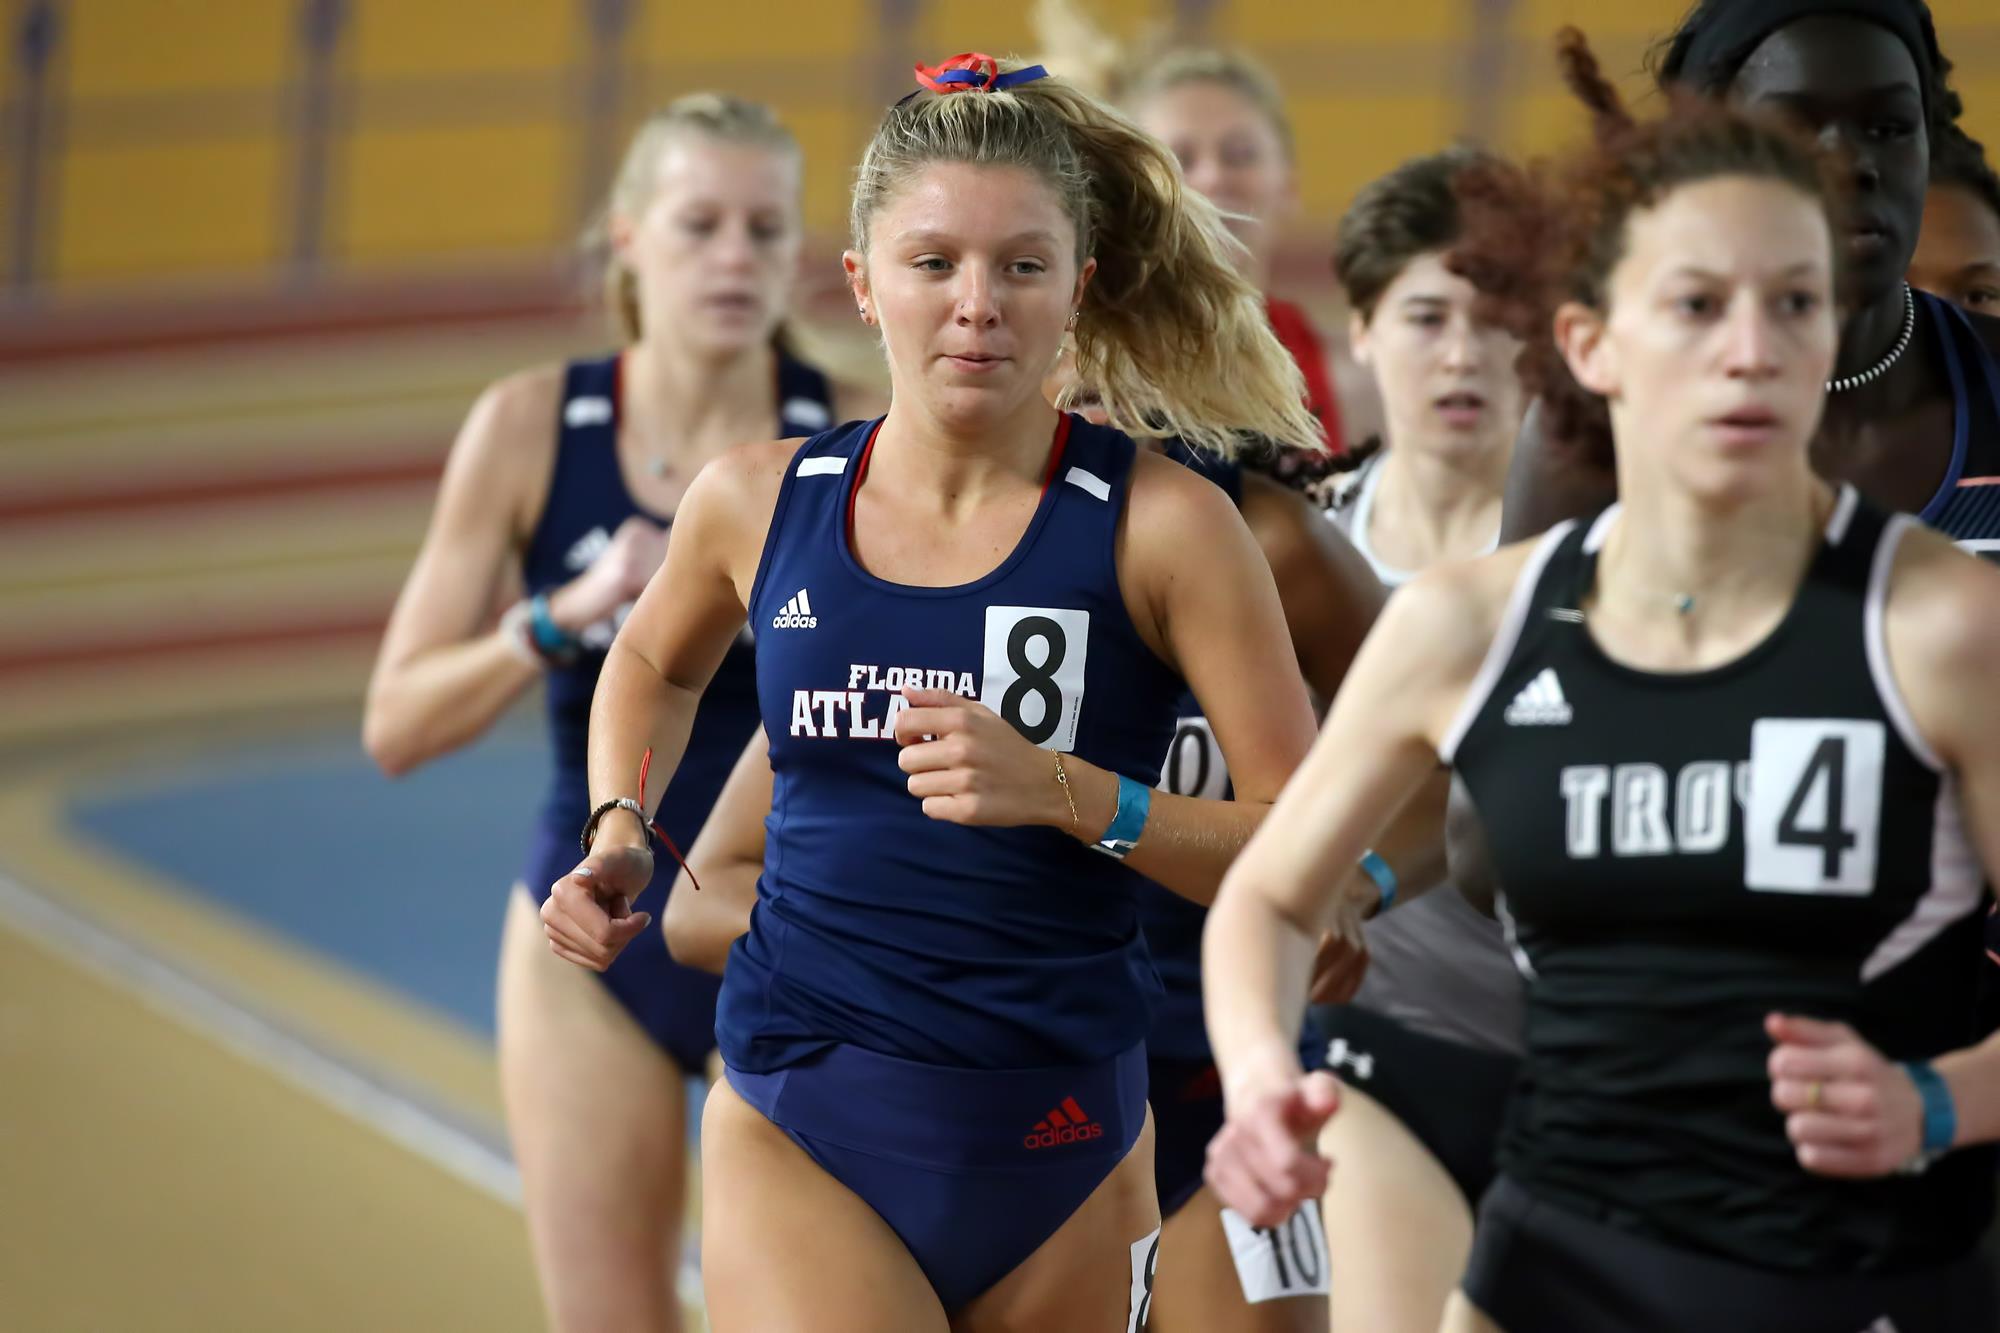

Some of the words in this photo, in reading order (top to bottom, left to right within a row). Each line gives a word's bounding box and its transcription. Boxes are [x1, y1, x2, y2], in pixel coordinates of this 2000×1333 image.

[773, 613, 817, 628] adidas
[848, 664, 976, 697] FLORIDA
[1000, 616, 1067, 744] 8
[1776, 734, 1857, 882] 4
[1024, 1122, 1102, 1149] adidas
